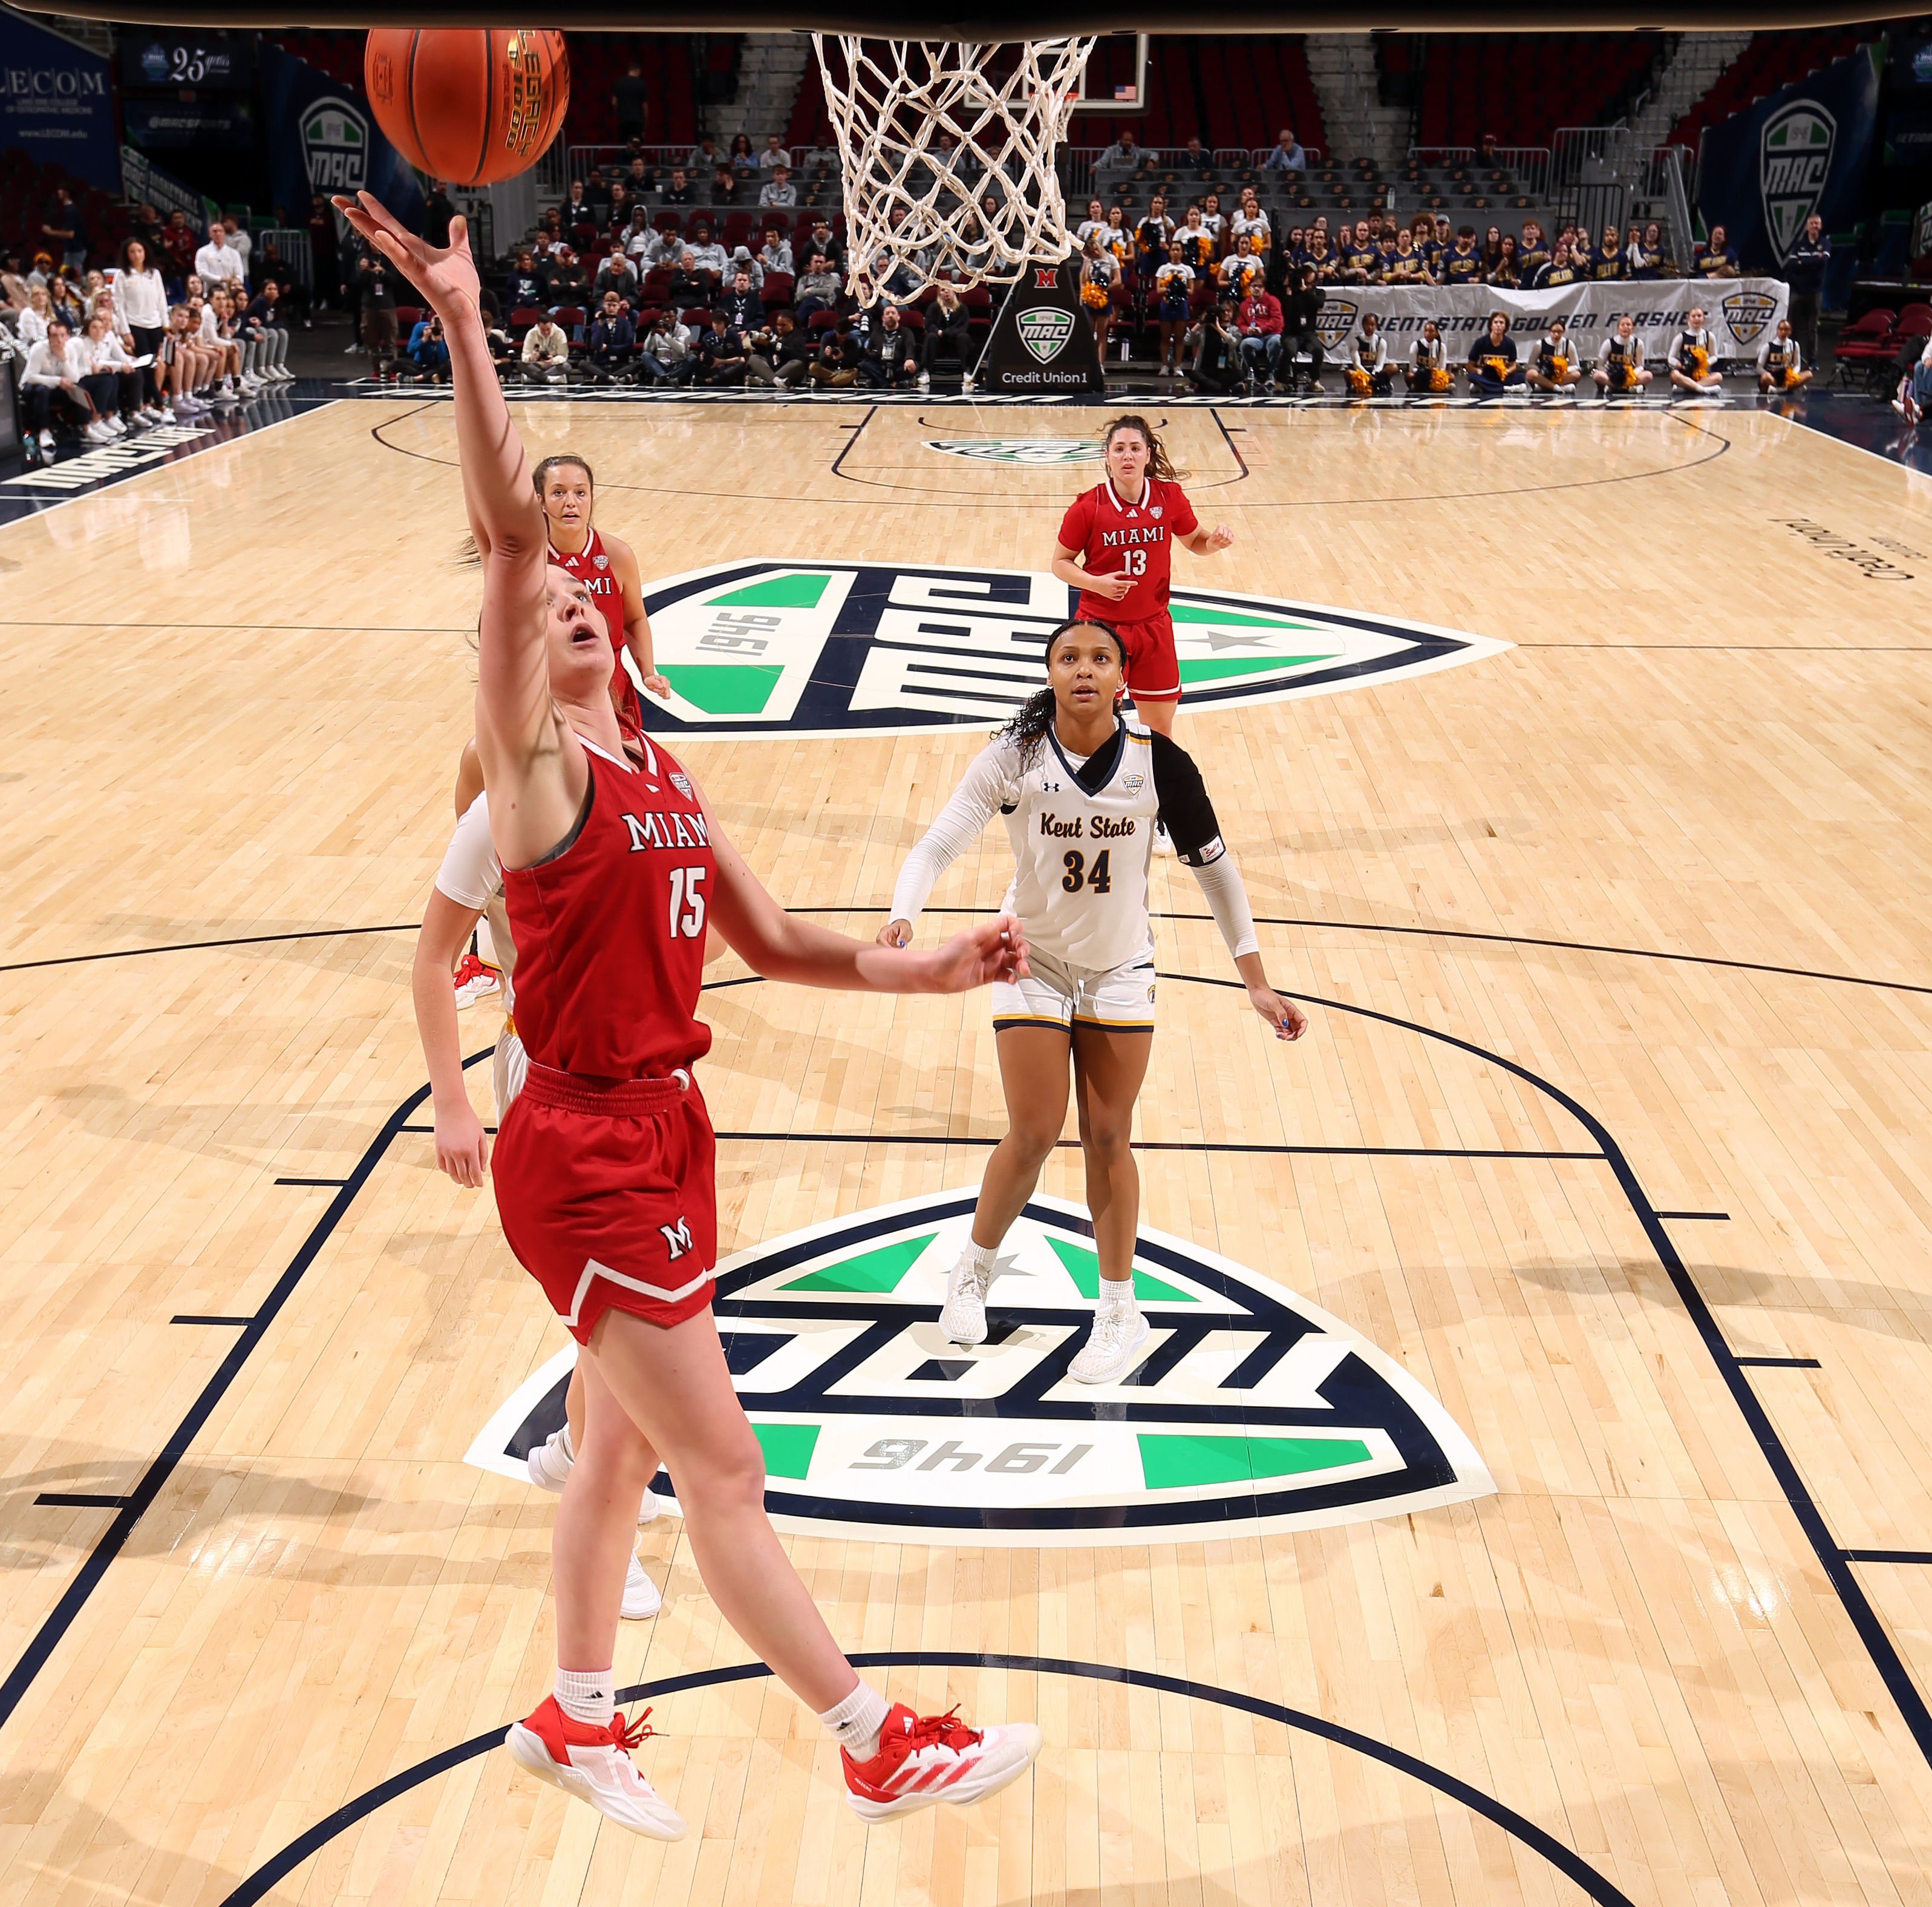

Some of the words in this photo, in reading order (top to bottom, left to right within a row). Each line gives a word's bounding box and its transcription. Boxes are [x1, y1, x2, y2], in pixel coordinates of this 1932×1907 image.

[168, 47, 206, 82] 25
[504, 73, 523, 150] 1000
[310, 151, 365, 189] MAC
[1765, 155, 1826, 194] MAC
[1034, 268, 1059, 289] M
[1437, 316, 1491, 332] STAT
[1605, 310, 1708, 327] FASHE
[1725, 309, 1772, 322] MAC
[1022, 325, 1069, 339] MAC
[1002, 371, 1040, 384] Credit
[1043, 371, 1080, 384] Union
[1082, 373, 1088, 383] 1
[359, 389, 1074, 403] MD-AMERICAN
[1104, 395, 1735, 408] CONFERENCE
[1101, 526, 1164, 546] MIAMI
[1122, 549, 1147, 577] 13
[695, 612, 782, 656] 1946
[621, 812, 712, 851] MIAM
[1040, 813, 1083, 839] Kent
[1090, 815, 1135, 839] State
[1062, 848, 1111, 894] 34
[670, 866, 706, 938] 15
[847, 1438, 1094, 1475] 1946
